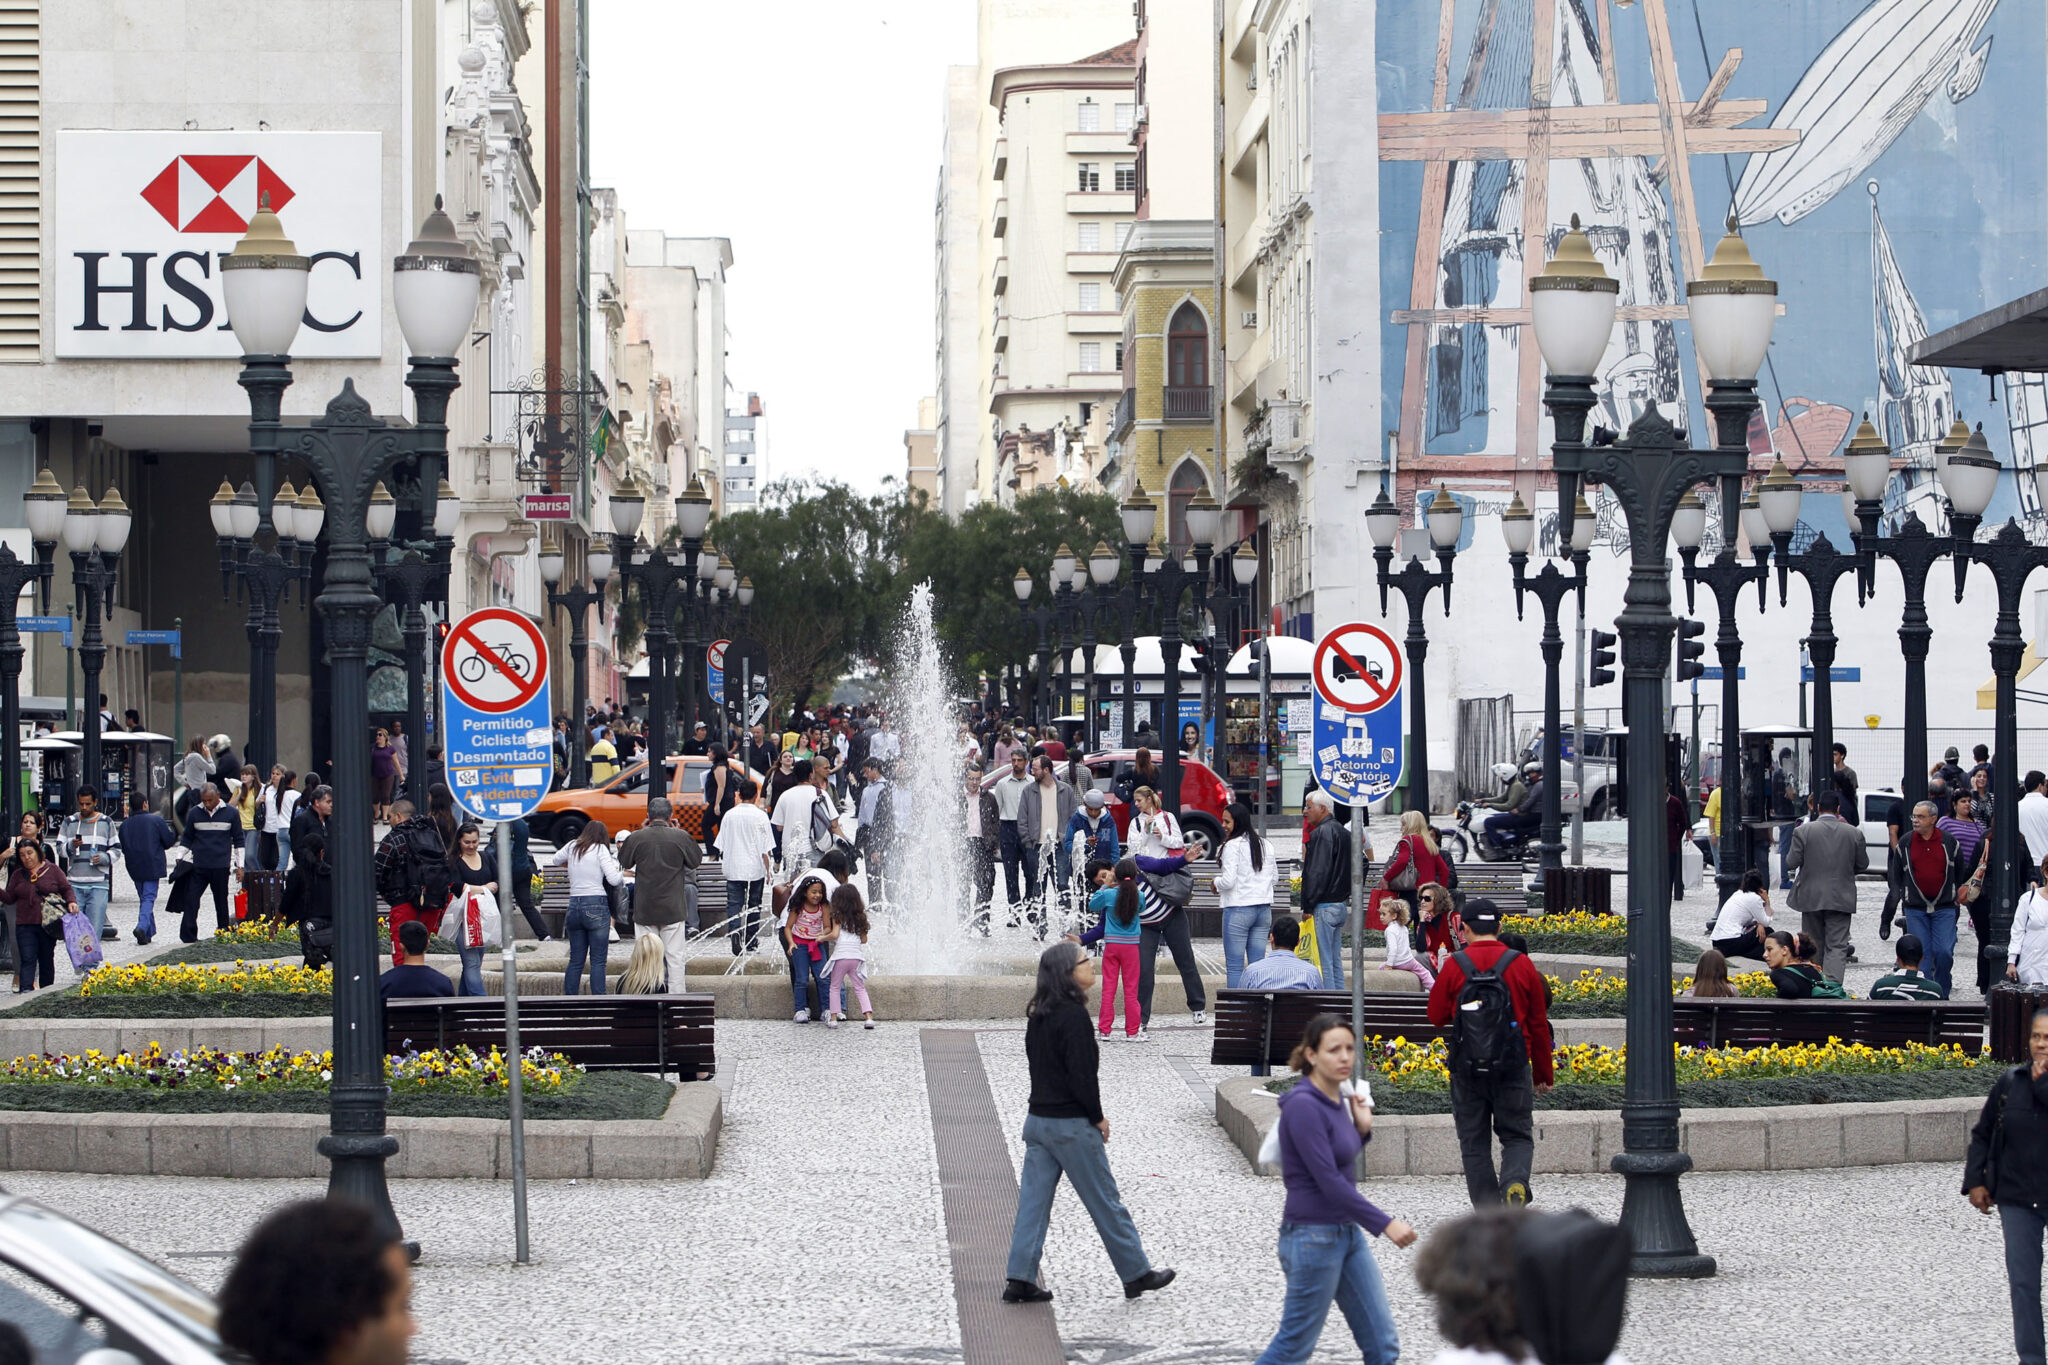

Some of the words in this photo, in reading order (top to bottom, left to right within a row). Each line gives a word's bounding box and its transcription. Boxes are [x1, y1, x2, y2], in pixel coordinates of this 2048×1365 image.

[73, 251, 362, 332] HSC
[526, 501, 570, 511] marisa
[463, 718, 534, 731] Permitido
[471, 733, 526, 747] Ciclista
[453, 749, 546, 763] Desmontado
[1333, 760, 1381, 770] Retorno
